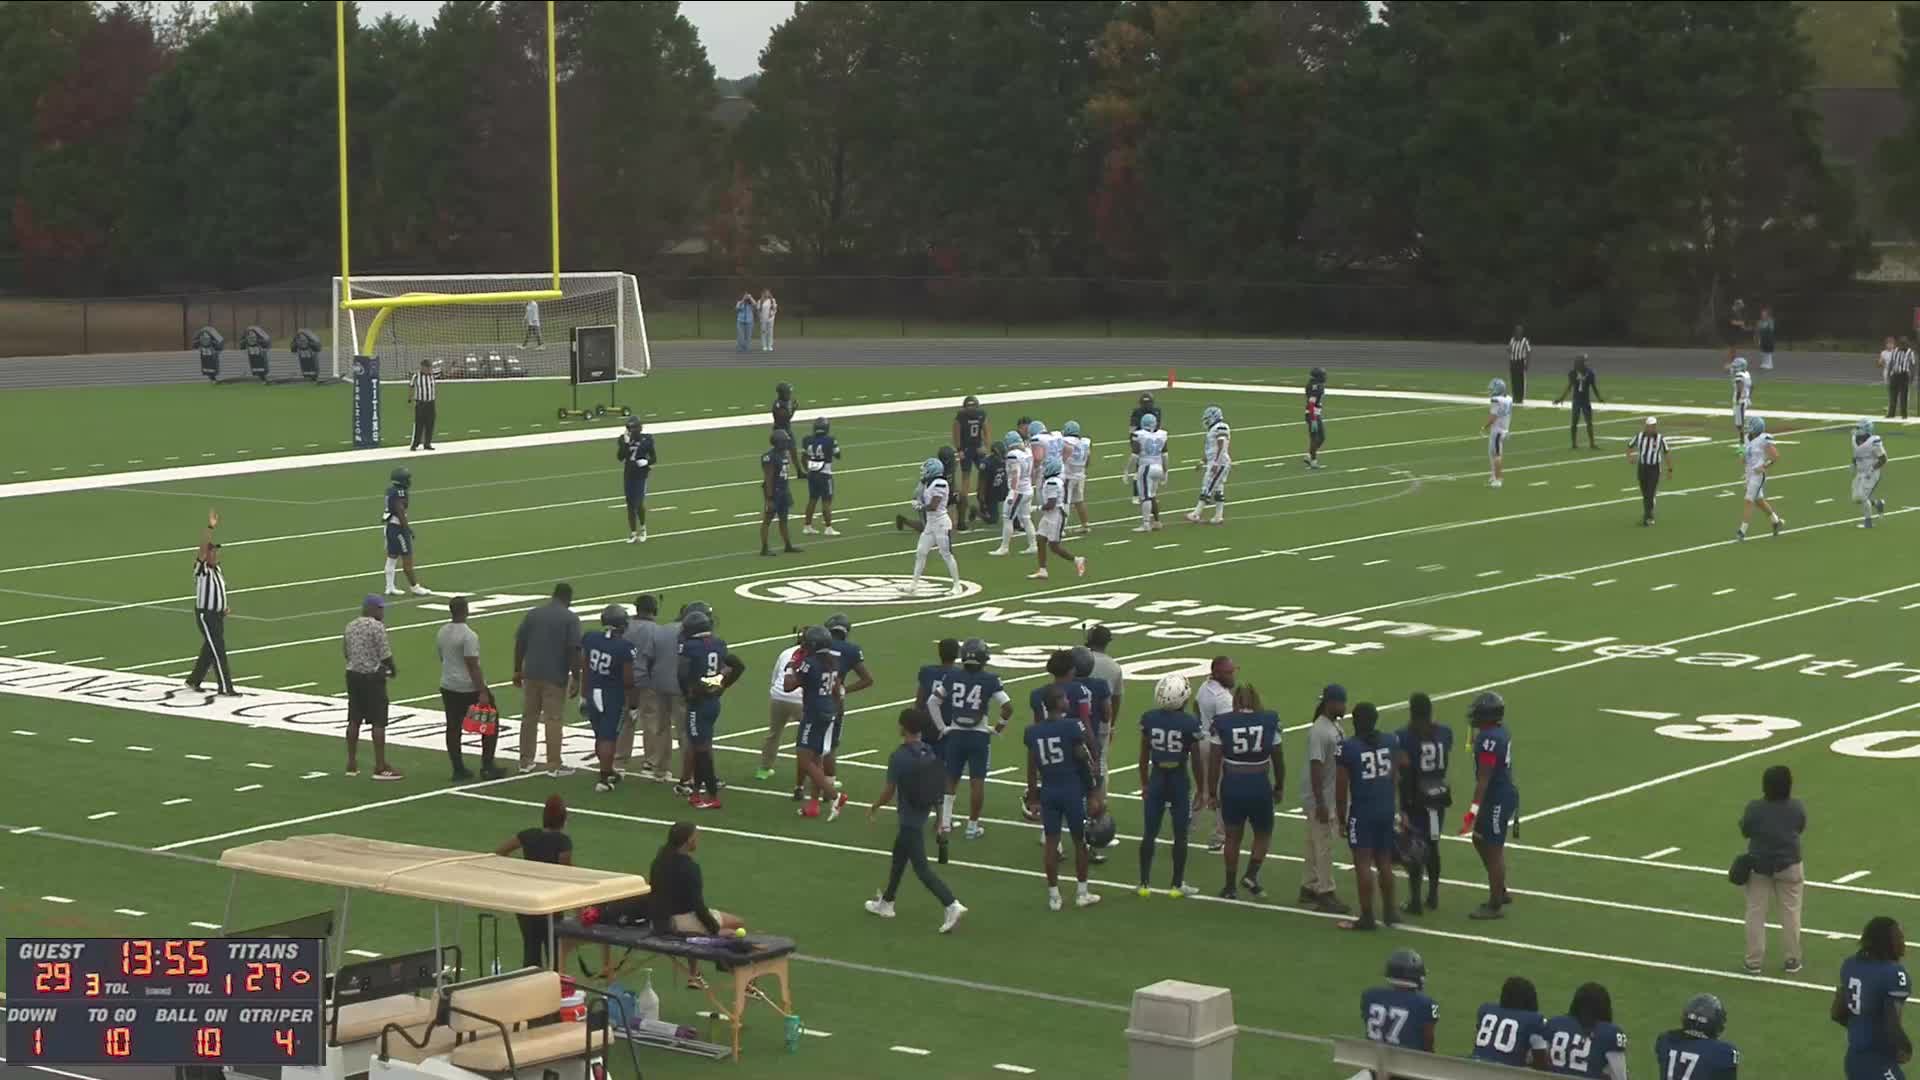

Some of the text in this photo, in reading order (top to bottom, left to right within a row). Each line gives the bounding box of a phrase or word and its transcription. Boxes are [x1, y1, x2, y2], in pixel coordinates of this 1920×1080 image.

[938, 606, 1386, 655] Navicent
[1023, 592, 1920, 684] Atrium Health
[589, 648, 612, 676] 92
[707, 652, 718, 677] 9
[952, 682, 983, 710] 24
[1151, 727, 1183, 753] 26
[1232, 725, 1264, 754] 57
[1653, 713, 1803, 742] 3
[1037, 736, 1065, 766] 15
[1420, 742, 1445, 772] 21
[1482, 738, 1497, 752] 47
[1361, 747, 1393, 780] 35
[1897, 971, 1907, 987] 3
[1848, 976, 1863, 1016] 3
[1367, 1003, 1409, 1045] 27
[1475, 1013, 1520, 1053] 80
[1550, 1030, 1592, 1073] 82
[1667, 1048, 1701, 1080] 17
